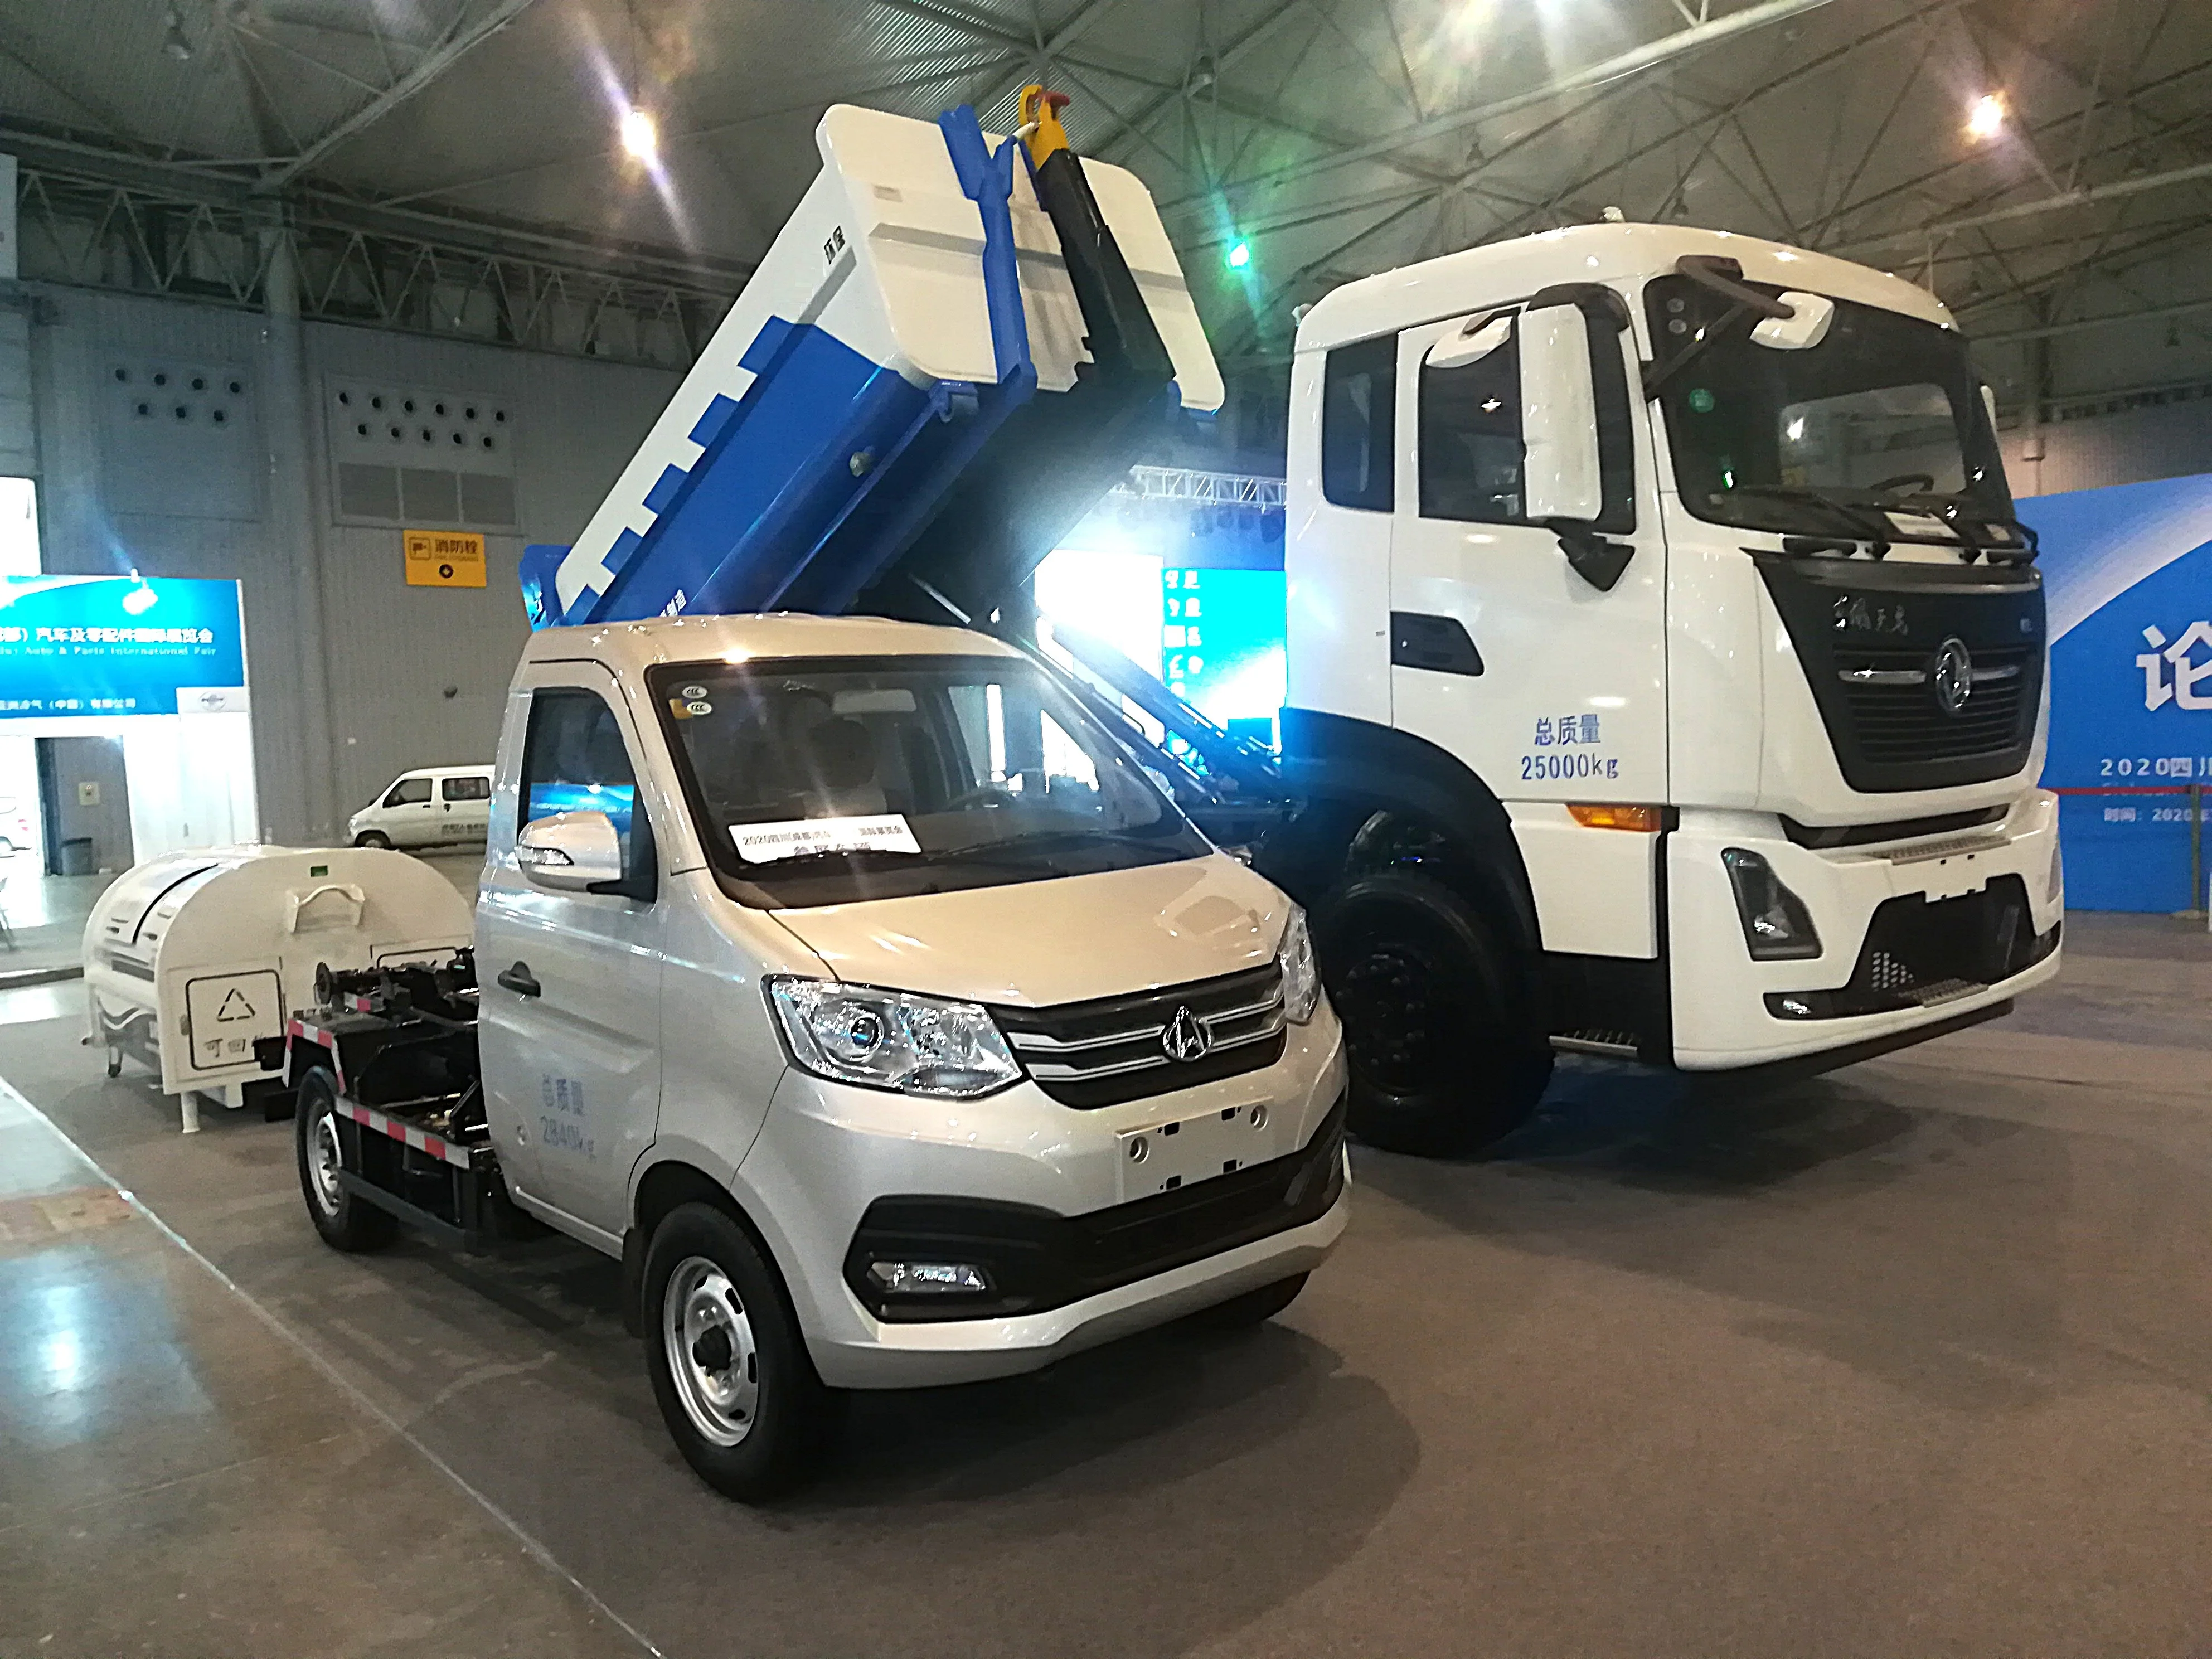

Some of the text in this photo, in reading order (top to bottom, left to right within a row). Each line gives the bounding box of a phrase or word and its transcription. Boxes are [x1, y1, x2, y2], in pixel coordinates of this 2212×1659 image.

[1534, 714, 1601, 746] 总质量
[1521, 753, 1619, 780] 25000kg
[203, 1033, 265, 1058] 可回
